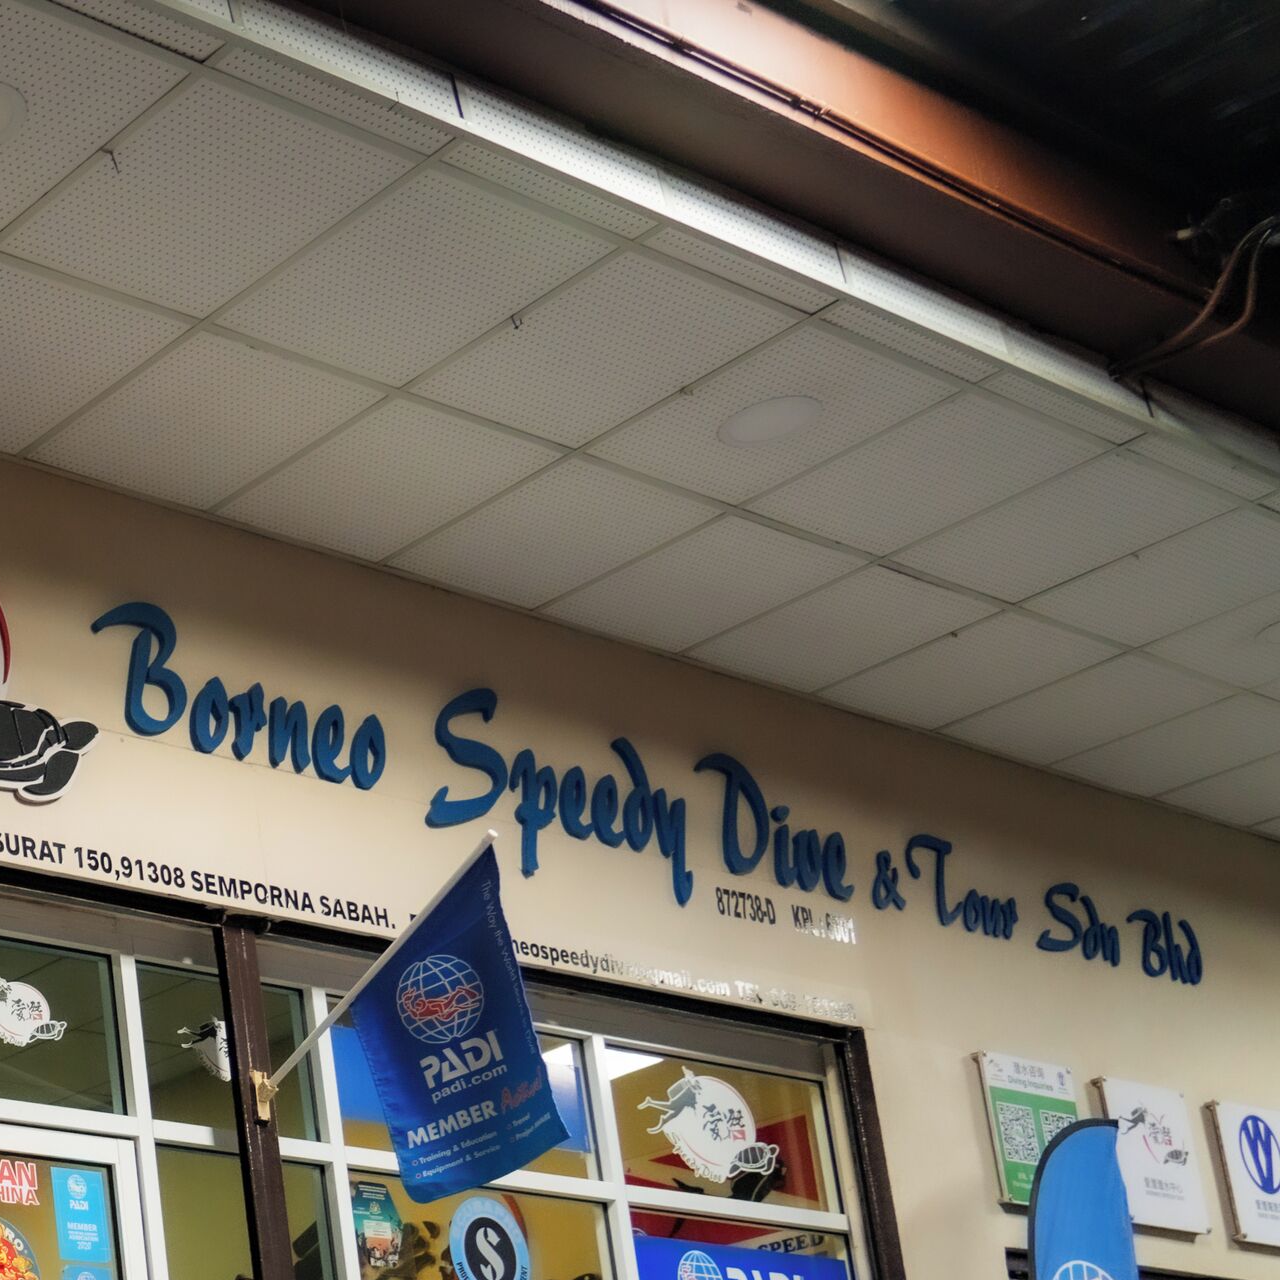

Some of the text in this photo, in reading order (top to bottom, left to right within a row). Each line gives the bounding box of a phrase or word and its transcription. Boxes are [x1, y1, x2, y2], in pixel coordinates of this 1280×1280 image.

[89, 599, 1203, 987] Borneo Speedy Dive & Tour Sdn Bhd
[74, 846, 186, 889] 150,91308
[191, 870, 315, 914] SEMPORNA
[319, 896, 397, 929] SABAH.
[715, 886, 776, 925] 872738-D
[419, 1030, 505, 1089] PADI
[432, 1064, 507, 1104] padi.com
[407, 1100, 498, 1149] MEMBER
[67, 1222, 97, 1232] MEMBER
[69, 1200, 89, 1211] PADI
